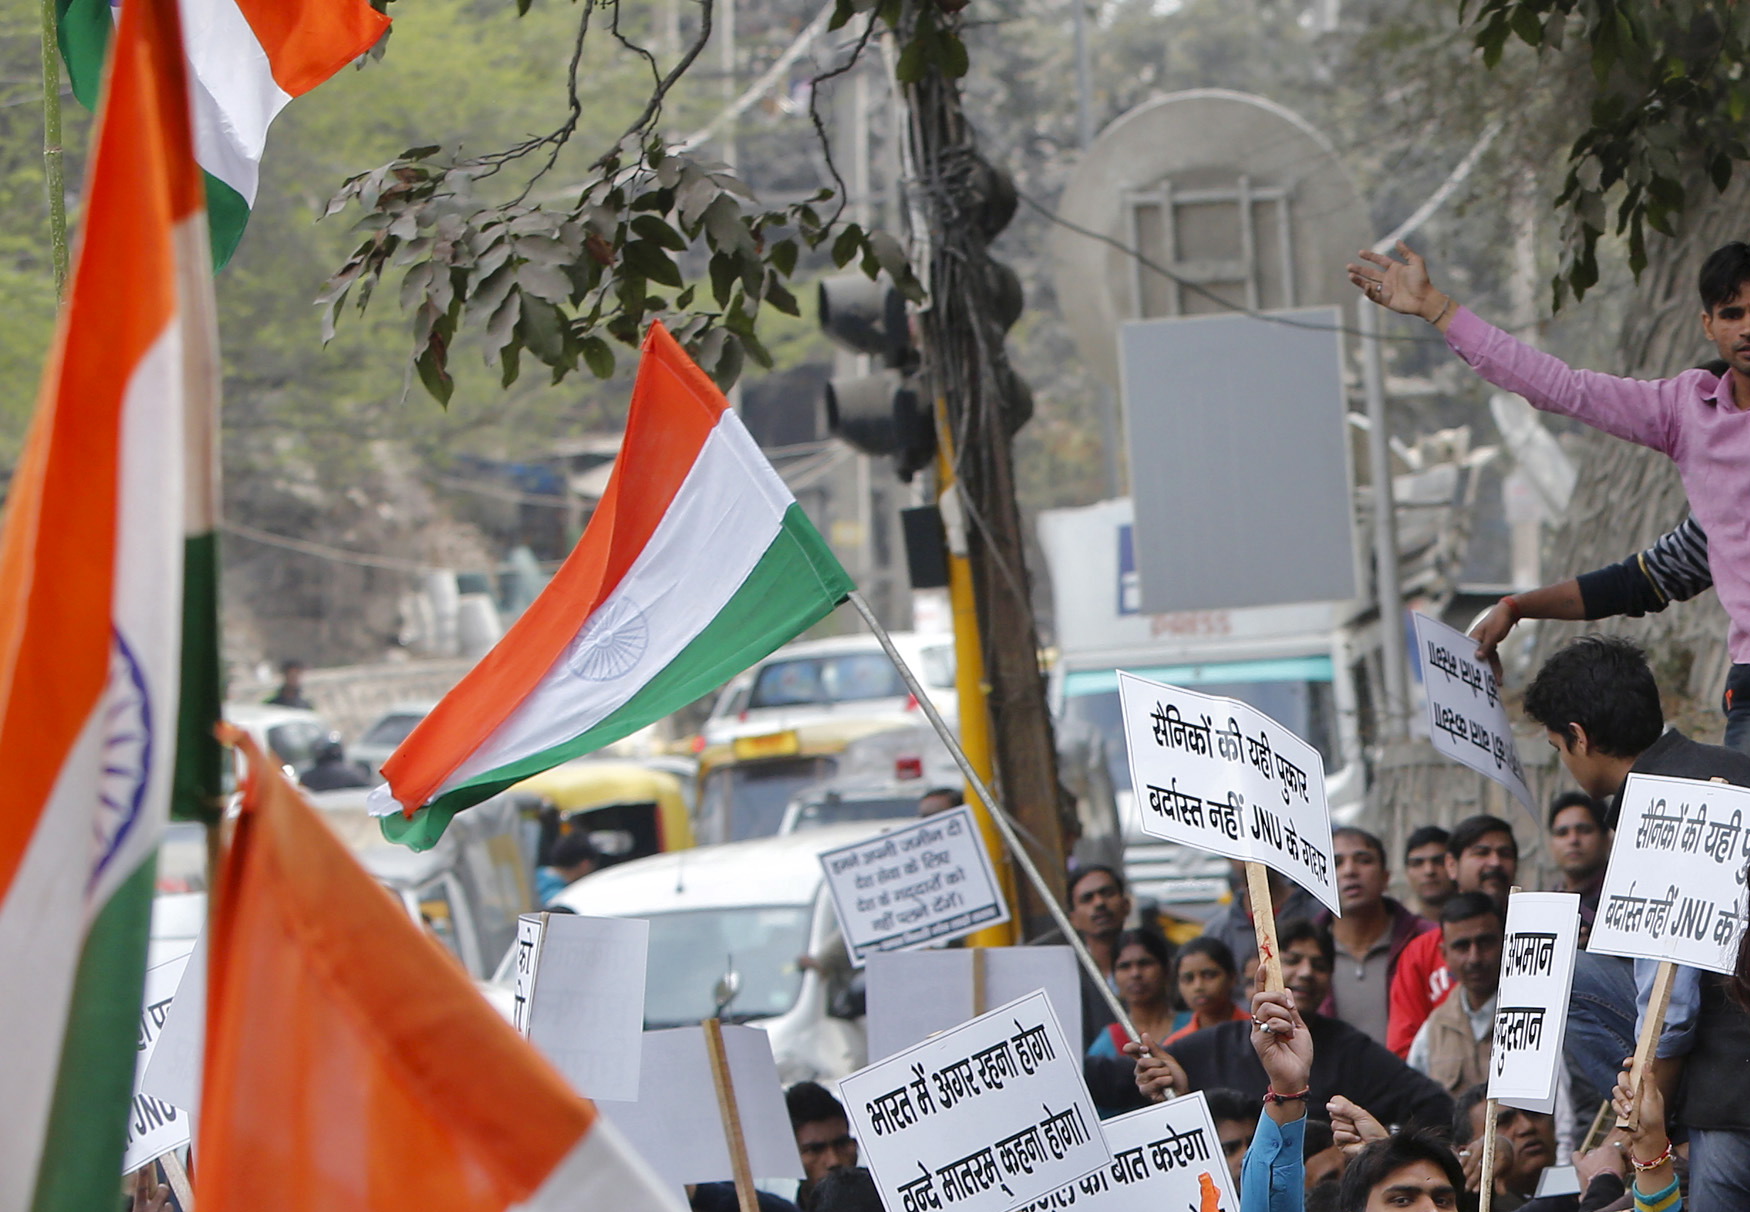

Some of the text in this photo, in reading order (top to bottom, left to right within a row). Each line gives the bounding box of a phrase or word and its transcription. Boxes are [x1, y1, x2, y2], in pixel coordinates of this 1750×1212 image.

[1150, 700, 1310, 806] सैनिकों की यही पुकार
[1147, 777, 1205, 829] बर्दास्त
[1206, 791, 1245, 841] नहीं
[1251, 804, 1283, 851] JNU
[1283, 817, 1300, 861] के
[1680, 802, 1707, 855] की
[1704, 809, 1743, 863] यही
[1643, 885, 1680, 939] नहीं
[1670, 897, 1715, 941] JNU
[865, 1018, 1056, 1137] भारत में अगर रहना होगा
[935, 1146, 1015, 1202] मातरम्
[994, 1125, 1049, 1176] कहना
[1111, 1146, 1150, 1186] बात
[1147, 1123, 1211, 1173] करेगा
